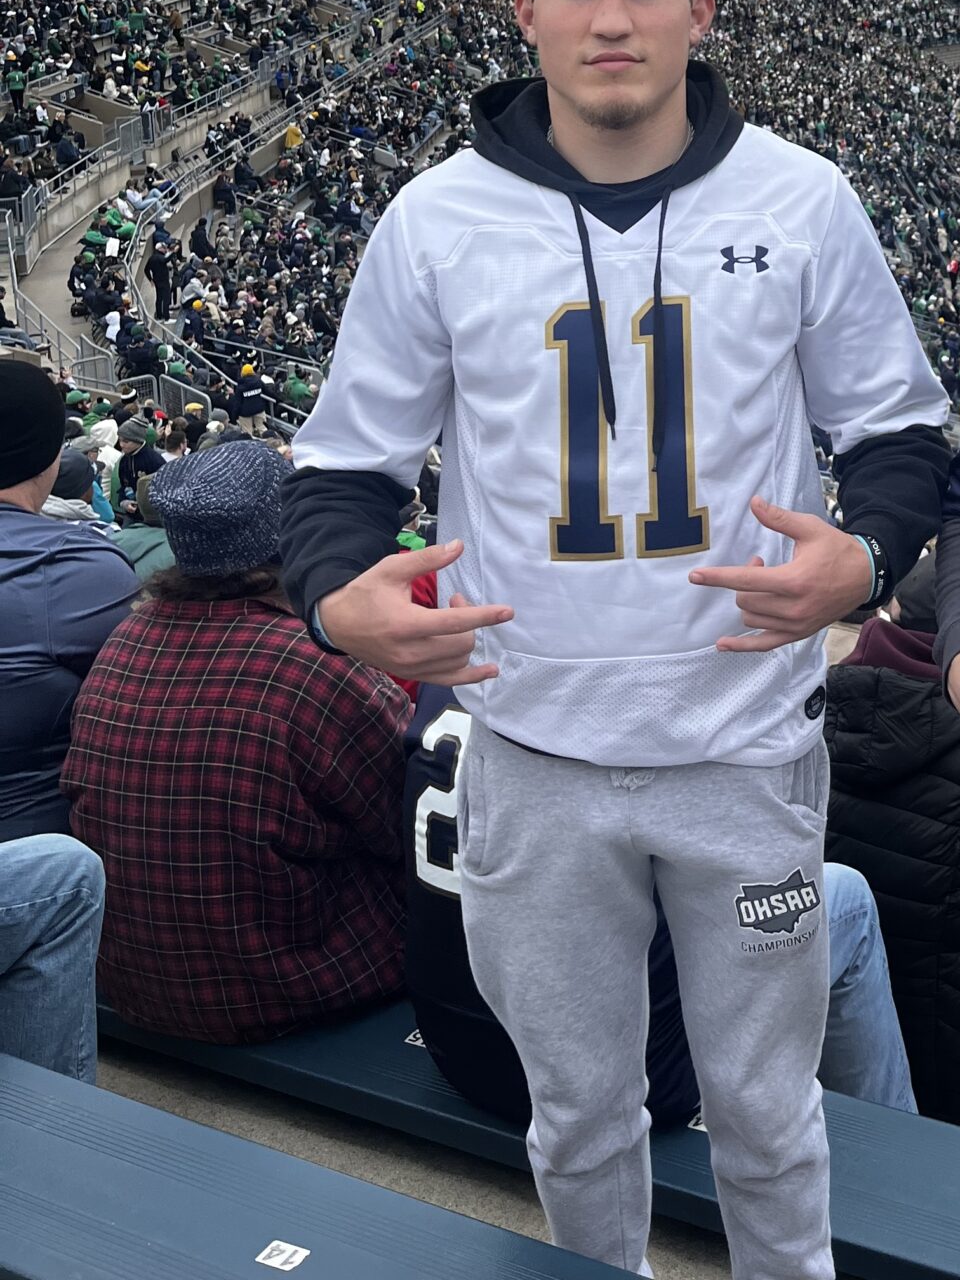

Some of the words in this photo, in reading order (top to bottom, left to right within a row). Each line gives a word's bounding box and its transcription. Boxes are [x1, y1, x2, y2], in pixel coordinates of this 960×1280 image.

[545, 295, 710, 561] 11
[870, 538, 881, 556] YOU
[740, 886, 817, 923] OHSAA
[262, 1244, 299, 1266] 14
